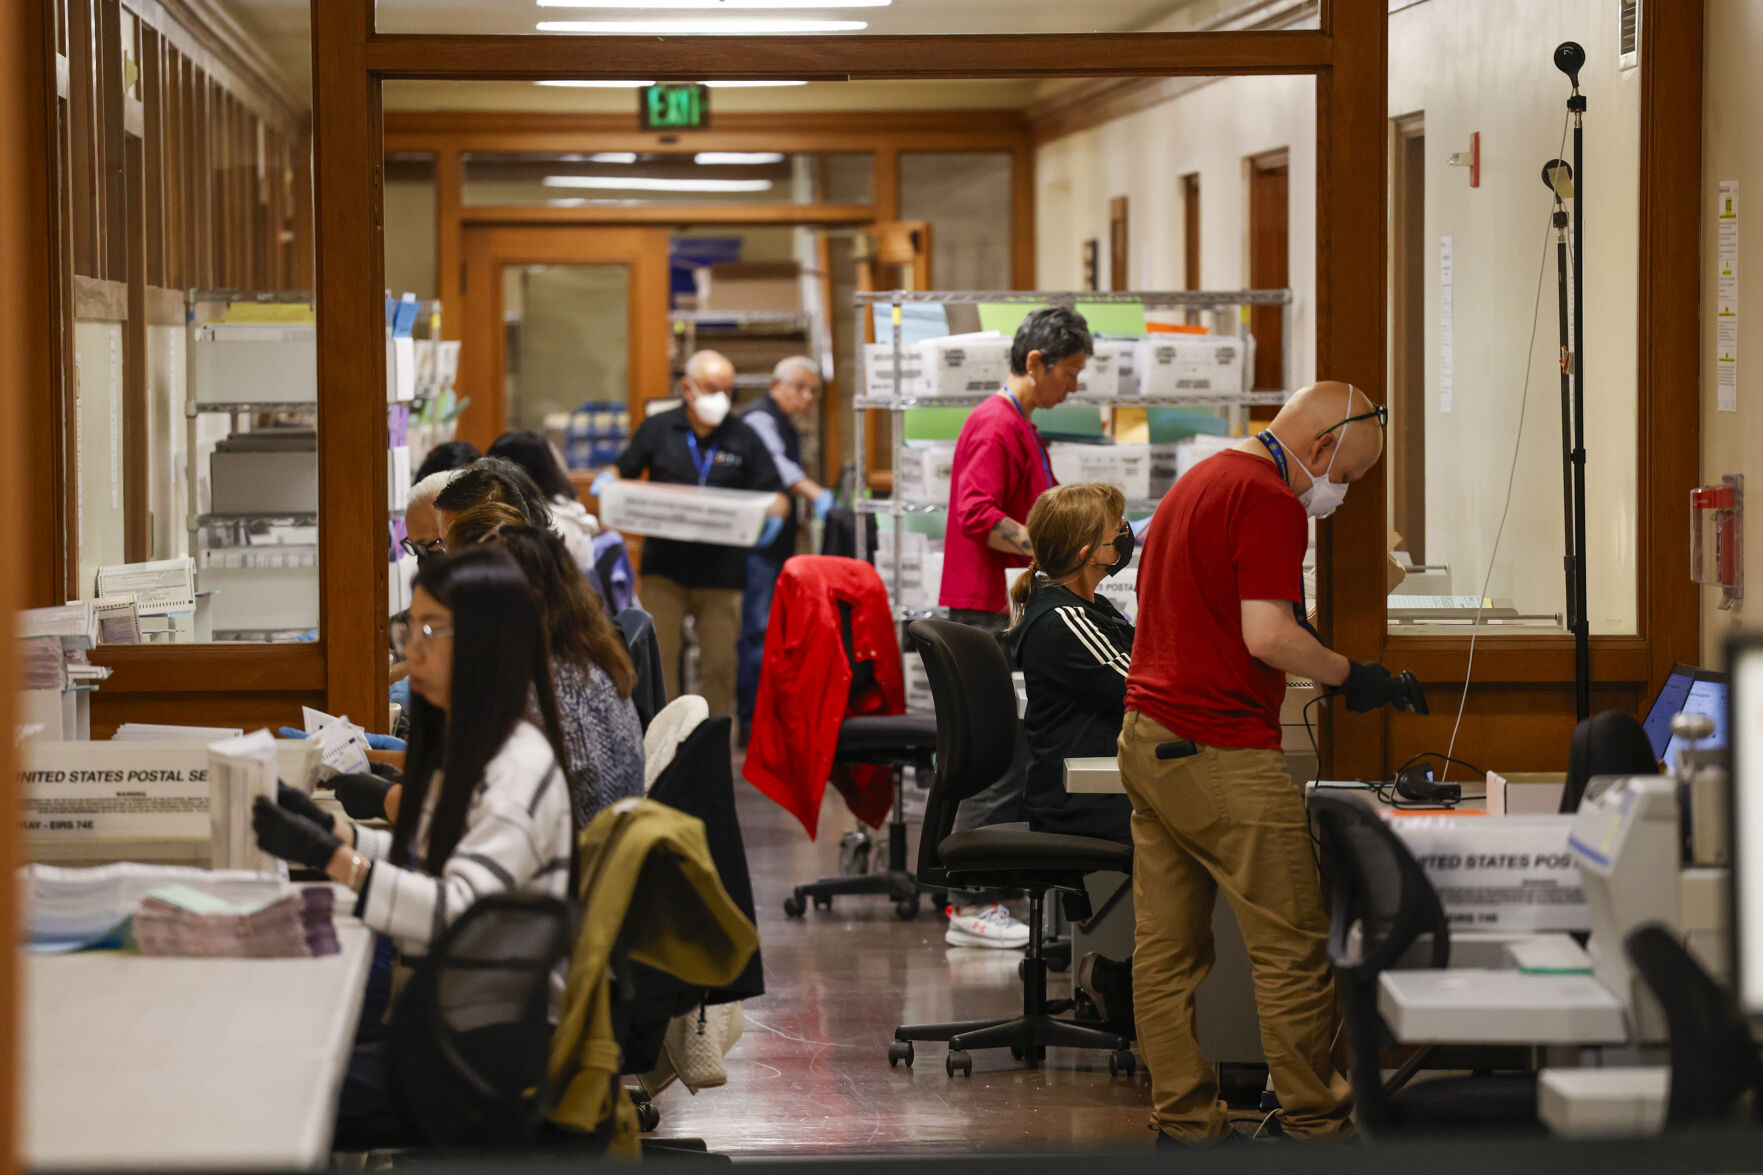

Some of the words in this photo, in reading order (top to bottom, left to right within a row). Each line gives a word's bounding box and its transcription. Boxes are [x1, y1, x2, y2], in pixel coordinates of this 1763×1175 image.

[647, 87, 703, 126] EXIT
[1106, 583, 1136, 591] POSTA
[17, 771, 66, 782] NITED
[69, 771, 124, 782] STATES
[127, 771, 184, 782] POSTAL
[50, 821, 74, 829] EIRS
[76, 821, 94, 829] 74E
[1416, 854, 1461, 869] ITED
[1465, 854, 1530, 869] STATES
[1534, 854, 1577, 869] POS
